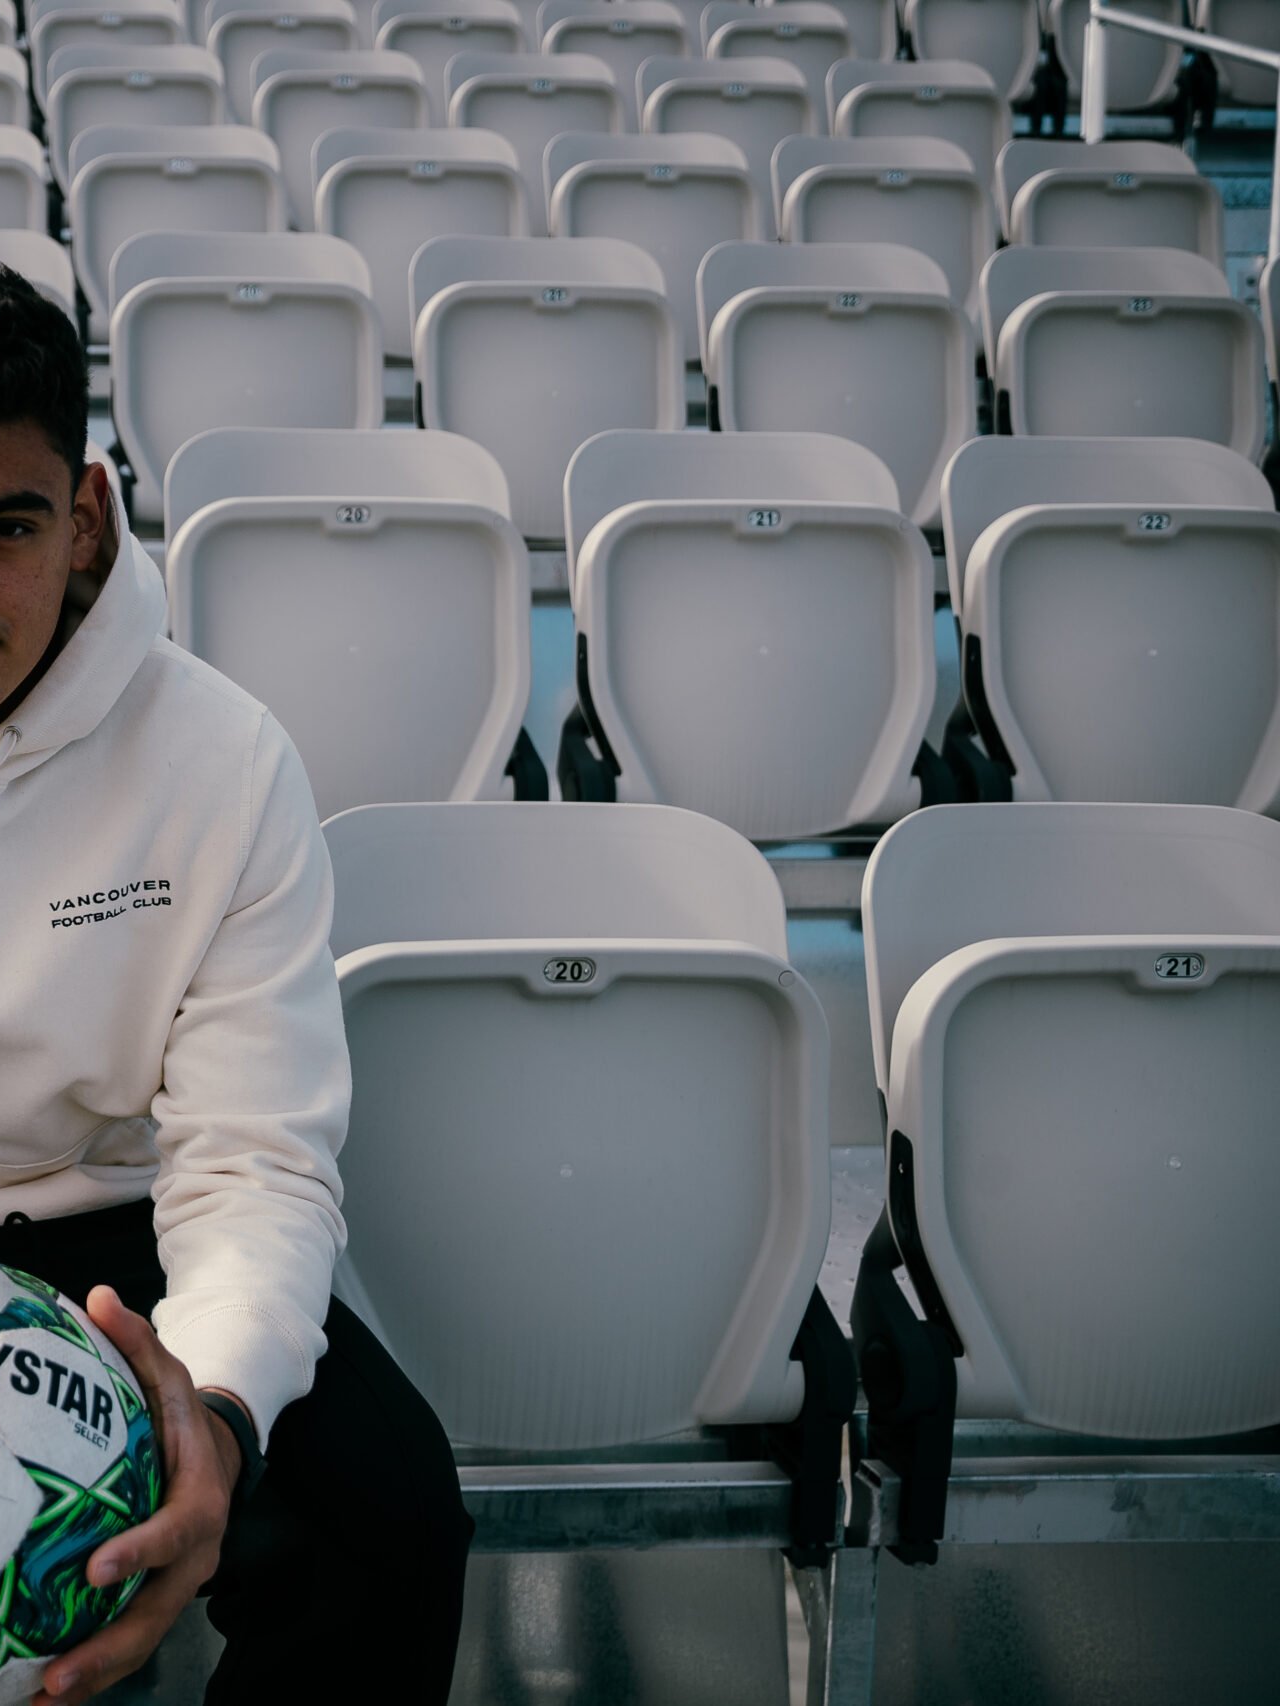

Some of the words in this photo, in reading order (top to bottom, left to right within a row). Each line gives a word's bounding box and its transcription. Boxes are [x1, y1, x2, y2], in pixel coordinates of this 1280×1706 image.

[344, 507, 363, 523] 20
[756, 511, 773, 526] 21
[1145, 515, 1164, 530] 22
[49, 880, 171, 912] VANCOUVER
[51, 906, 127, 929] FOOTBALL
[132, 897, 172, 909] CLUB
[554, 962, 583, 981] 20
[1166, 957, 1192, 976] 21
[73, 1422, 110, 1452] SELECT
